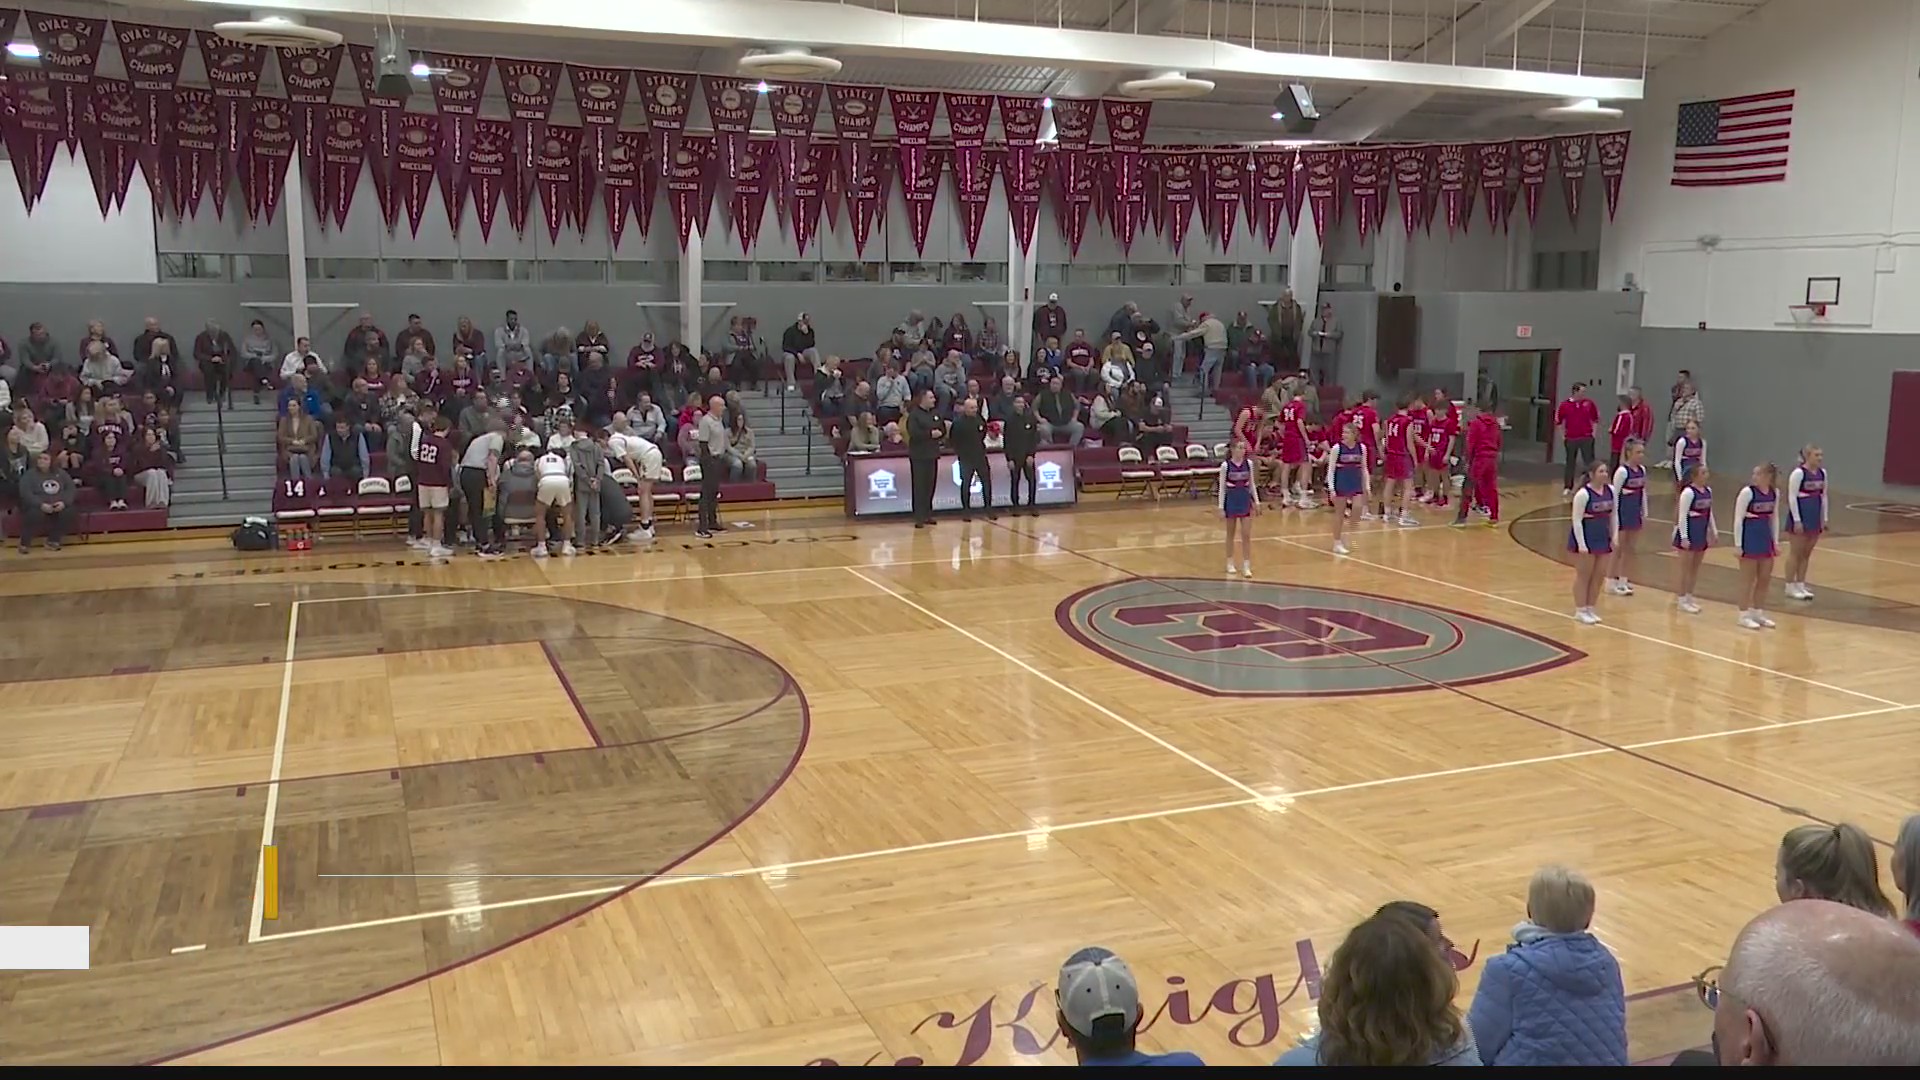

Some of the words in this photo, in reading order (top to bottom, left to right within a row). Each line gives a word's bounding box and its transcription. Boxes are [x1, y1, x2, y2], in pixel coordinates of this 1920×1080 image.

[38, 19, 69, 33] OVAC
[76, 22, 92, 36] 2A
[120, 28, 151, 44] OVAC
[45, 52, 92, 66] CHAMPS
[129, 59, 175, 75] CHAMPS
[508, 65, 542, 76] STATE
[49, 72, 89, 83] WHEELING
[210, 69, 256, 83] CHAMPS
[288, 74, 331, 89] CHAMPS
[578, 71, 612, 81] STATE
[646, 76, 679, 86] STATE
[96, 82, 127, 94] OVAC
[134, 81, 172, 91] WHEELING
[175, 92, 211, 104] STATE
[215, 88, 252, 98] WHEELING
[438, 87, 477, 100] CHAMPS
[511, 92, 548, 105] CHAMPS
[837, 89, 867, 100] STATE
[895, 93, 921, 103] STATE
[291, 94, 327, 104] WHEELING
[369, 98, 400, 107] WHEELING
[951, 96, 978, 106] STATE
[1005, 99, 1031, 108] STATE
[443, 105, 473, 115] WHEELING
[581, 99, 617, 111] CHAMPS
[649, 103, 683, 115] CHAMPS
[516, 110, 544, 119] WHEELING
[715, 107, 748, 119] CHAMPS
[777, 112, 809, 124] CHAMPS
[101, 112, 142, 127] CHAMPS
[586, 116, 614, 124] WHEELING
[653, 120, 680, 129] WHEELING
[839, 116, 871, 127] CHAMPS
[178, 120, 217, 135] CHAMPS
[718, 124, 745, 132] WHEELING
[899, 121, 929, 132] CHAMPS
[953, 123, 984, 134] CHAMPS
[1006, 122, 1036, 134] CHAMPS
[102, 131, 140, 142] WHEELING
[253, 129, 291, 142] CHAMPS
[843, 131, 868, 139] WHEELING
[178, 139, 214, 150] WHEELING
[326, 136, 363, 149] CHAMPS
[900, 137, 926, 145] WHEELING
[955, 139, 982, 147] WHEELING
[1008, 138, 1036, 146] WHEELING
[255, 147, 288, 156] WHEELING
[398, 144, 434, 158] CHAMPS
[327, 154, 360, 164] WHEELING
[469, 151, 504, 163] CHAMPS
[537, 156, 571, 168] CHAMPS
[1164, 156, 1187, 167] STATE
[1212, 155, 1235, 166] STATE
[400, 162, 432, 171] WHEELING
[470, 167, 502, 175] WHEELING
[538, 172, 569, 181] WHEELING
[420, 445, 438, 463] 22
[285, 481, 304, 496] 14
